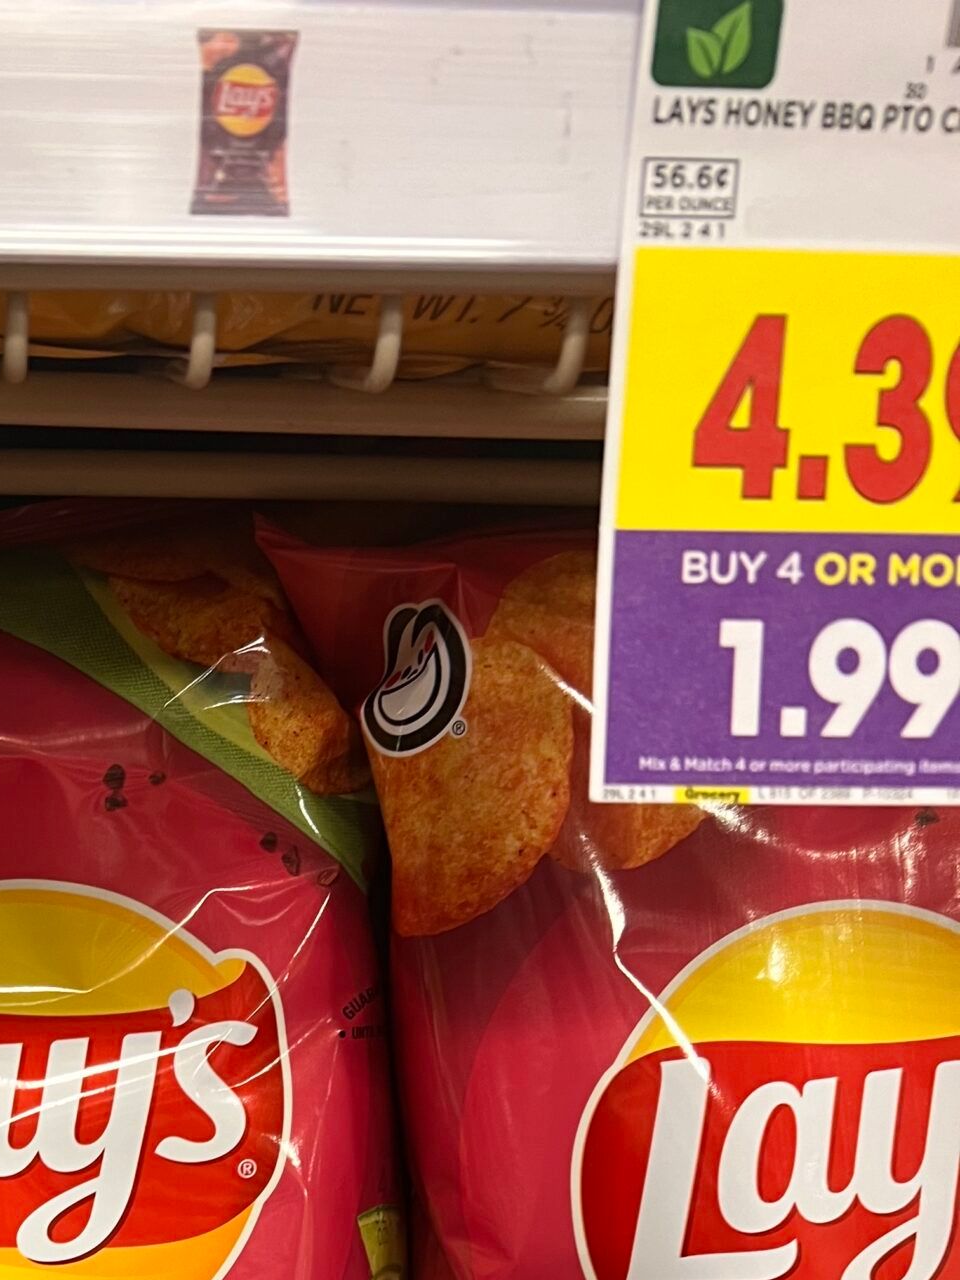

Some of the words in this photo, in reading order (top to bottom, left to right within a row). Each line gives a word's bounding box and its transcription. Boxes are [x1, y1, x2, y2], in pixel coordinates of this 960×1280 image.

[652, 97, 716, 127] LAYS
[724, 99, 815, 130] HONEY
[821, 101, 874, 131] BBQ
[882, 104, 933, 133] PTO
[652, 164, 730, 191] 56.6¢
[645, 198, 674, 212] PER
[679, 198, 732, 213] OUNCE
[701, 222, 711, 239] 4
[691, 312, 960, 506] 4.3
[681, 551, 767, 585] BUY
[777, 551, 804, 585] 4
[814, 552, 876, 587] OR
[888, 553, 960, 588] MO
[719, 617, 960, 738] 1.99
[639, 757, 667, 772] Mix
[669, 757, 682, 772] &
[684, 757, 733, 773] Match
[735, 758, 746, 773] 4
[749, 760, 767, 773] or
[769, 760, 811, 774] more
[814, 759, 916, 776] participating
